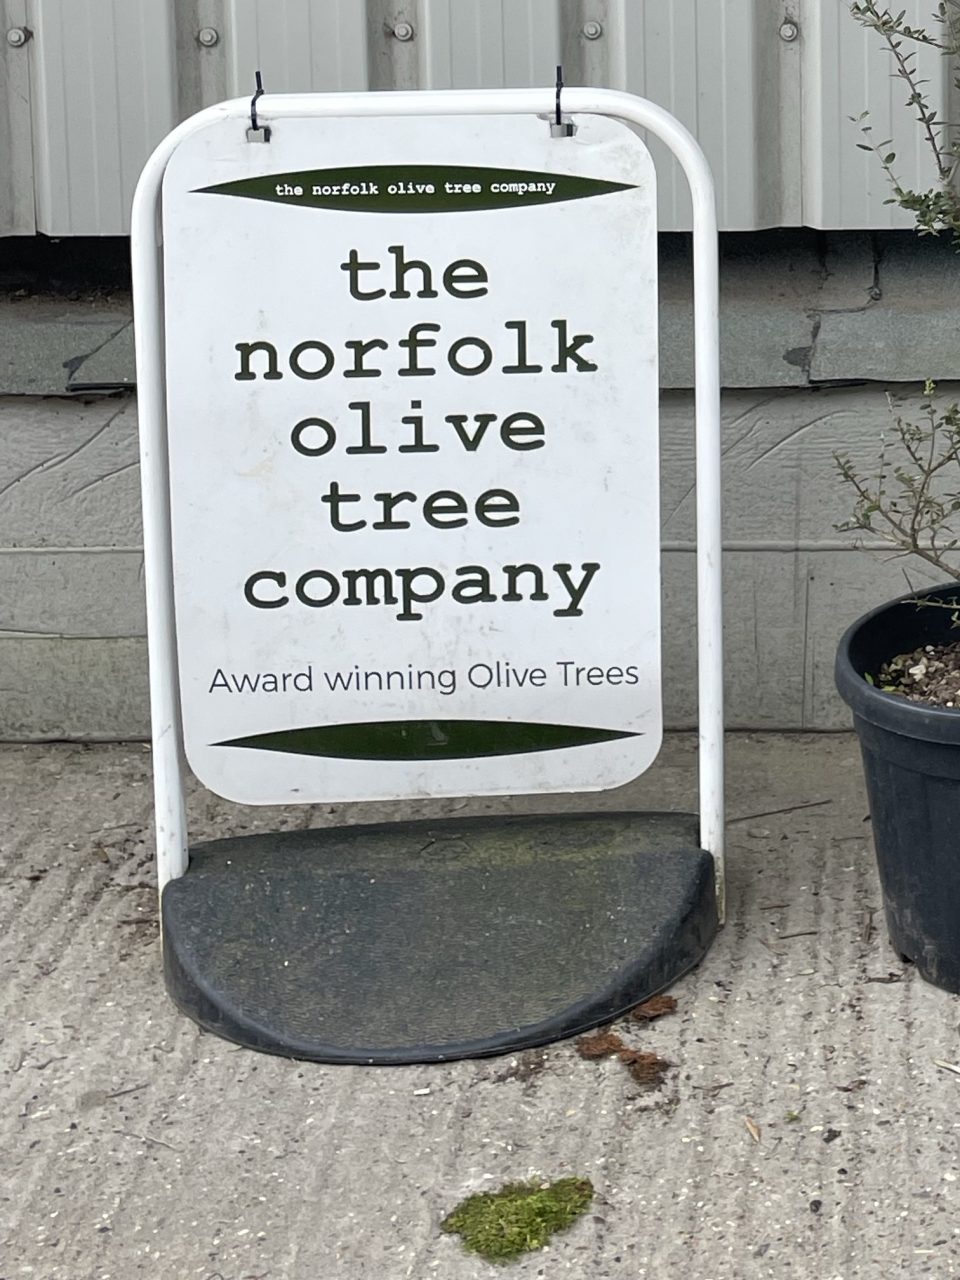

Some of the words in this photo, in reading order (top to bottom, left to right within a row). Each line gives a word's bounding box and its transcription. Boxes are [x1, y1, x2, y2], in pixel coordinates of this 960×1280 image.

[275, 182, 304, 197] the
[312, 182, 379, 196] norfolk
[387, 181, 435, 195] olive
[444, 181, 482, 194] tree
[490, 180, 556, 197] company
[340, 245, 489, 301] the
[234, 319, 598, 381] norfolk
[290, 399, 546, 457] olive
[320, 481, 520, 533] tree
[243, 562, 601, 622] company
[208, 665, 314, 694] Award
[323, 663, 457, 696] winning
[467, 660, 547, 690] Olive
[556, 661, 640, 687] Trees
